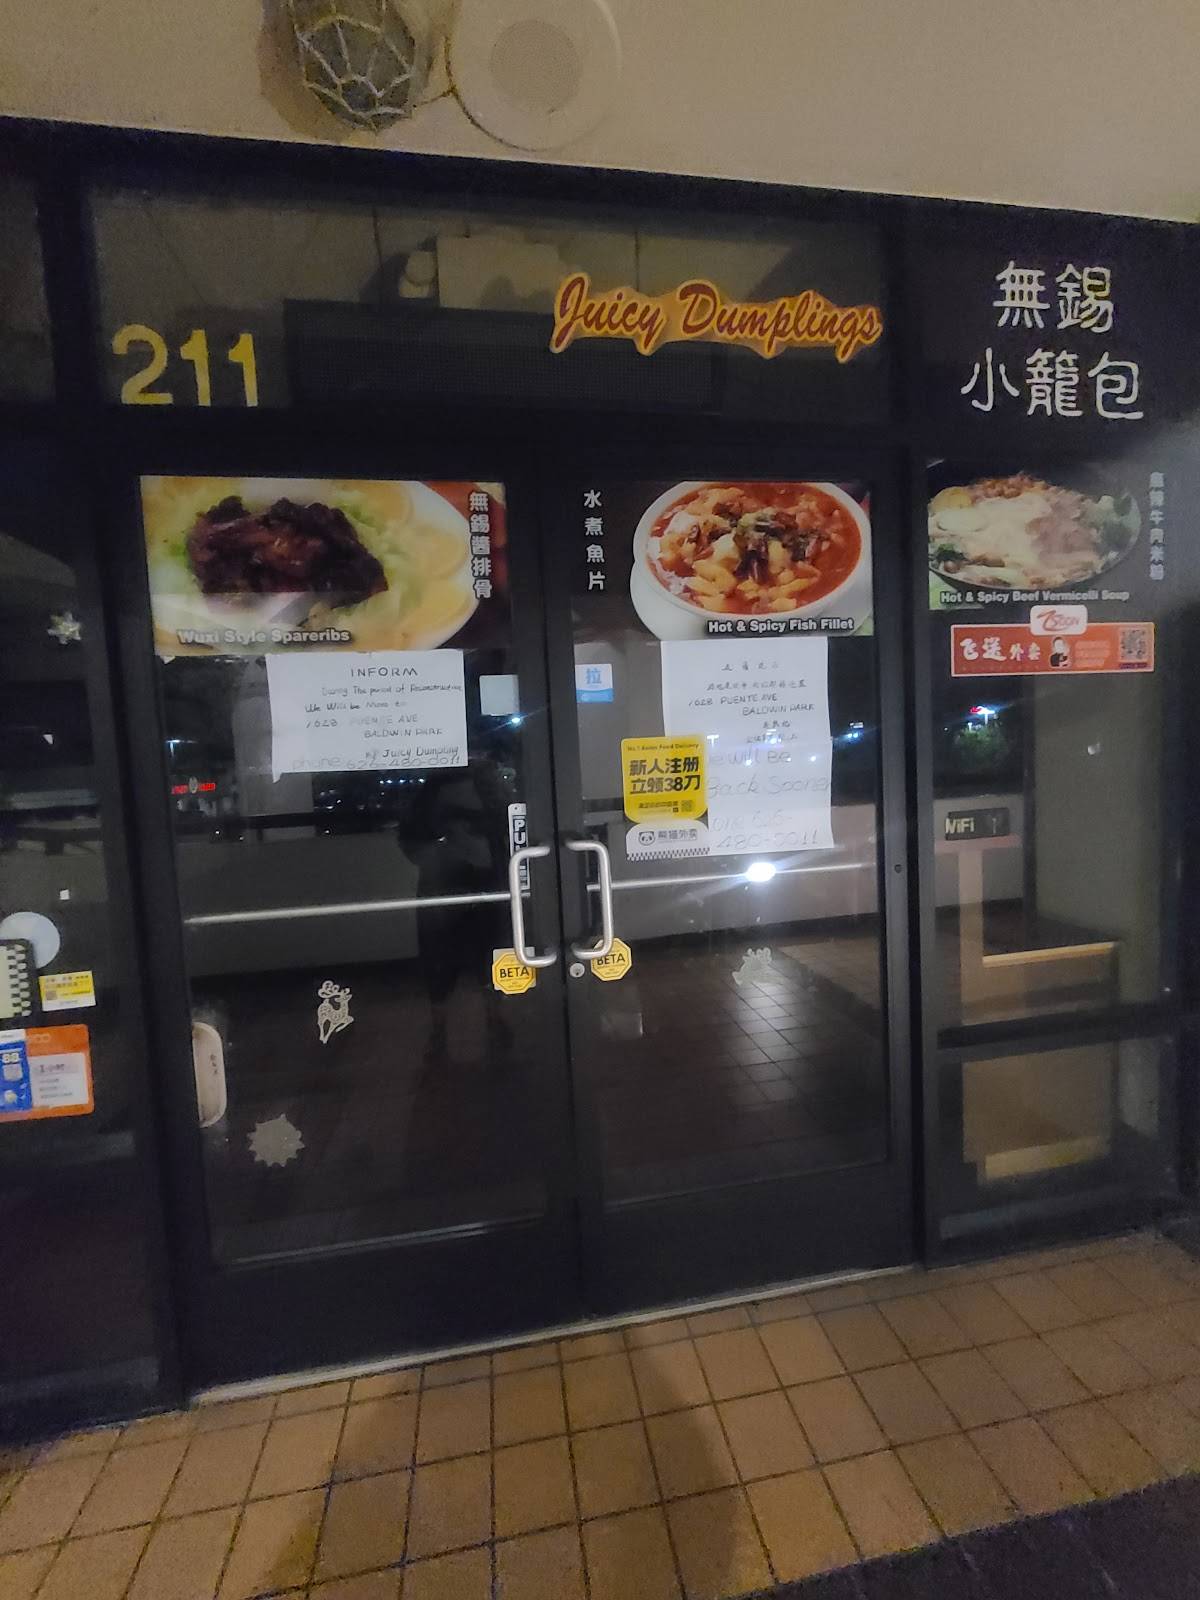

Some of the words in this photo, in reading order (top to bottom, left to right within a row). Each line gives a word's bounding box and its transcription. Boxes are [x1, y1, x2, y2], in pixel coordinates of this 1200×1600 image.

[993, 260, 1114, 333] 無錫
[553, 276, 663, 349] Juicy
[679, 282, 880, 359] Dumplings
[112, 324, 258, 407] 211
[960, 347, 1144, 420] 小籠包
[469, 492, 493, 599] 無錫醬排骨
[583, 489, 606, 590] 水煮魚片
[941, 591, 961, 603] Hot
[966, 592, 974, 601] &
[977, 591, 1009, 604] Spicy
[1012, 590, 1039, 602] Beef
[1102, 590, 1130, 602] Soup
[708, 620, 733, 633] Hot
[736, 621, 747, 632] &
[750, 620, 786, 633] Spicy
[789, 619, 817, 631] Fish
[820, 618, 855, 630] Fillet
[176, 629, 220, 644] Wuxi
[224, 629, 265, 646] Style
[271, 628, 351, 646] Spareribs
[350, 666, 419, 678] INFORM
[585, 667, 603, 685] 拉
[742, 705, 787, 717] BALDWIN
[364, 729, 412, 739] BALDWIN
[629, 756, 699, 777] 新人注册
[629, 774, 701, 795] 立领38刀
[596, 952, 626, 966] BETA
[499, 966, 530, 979] BETA
